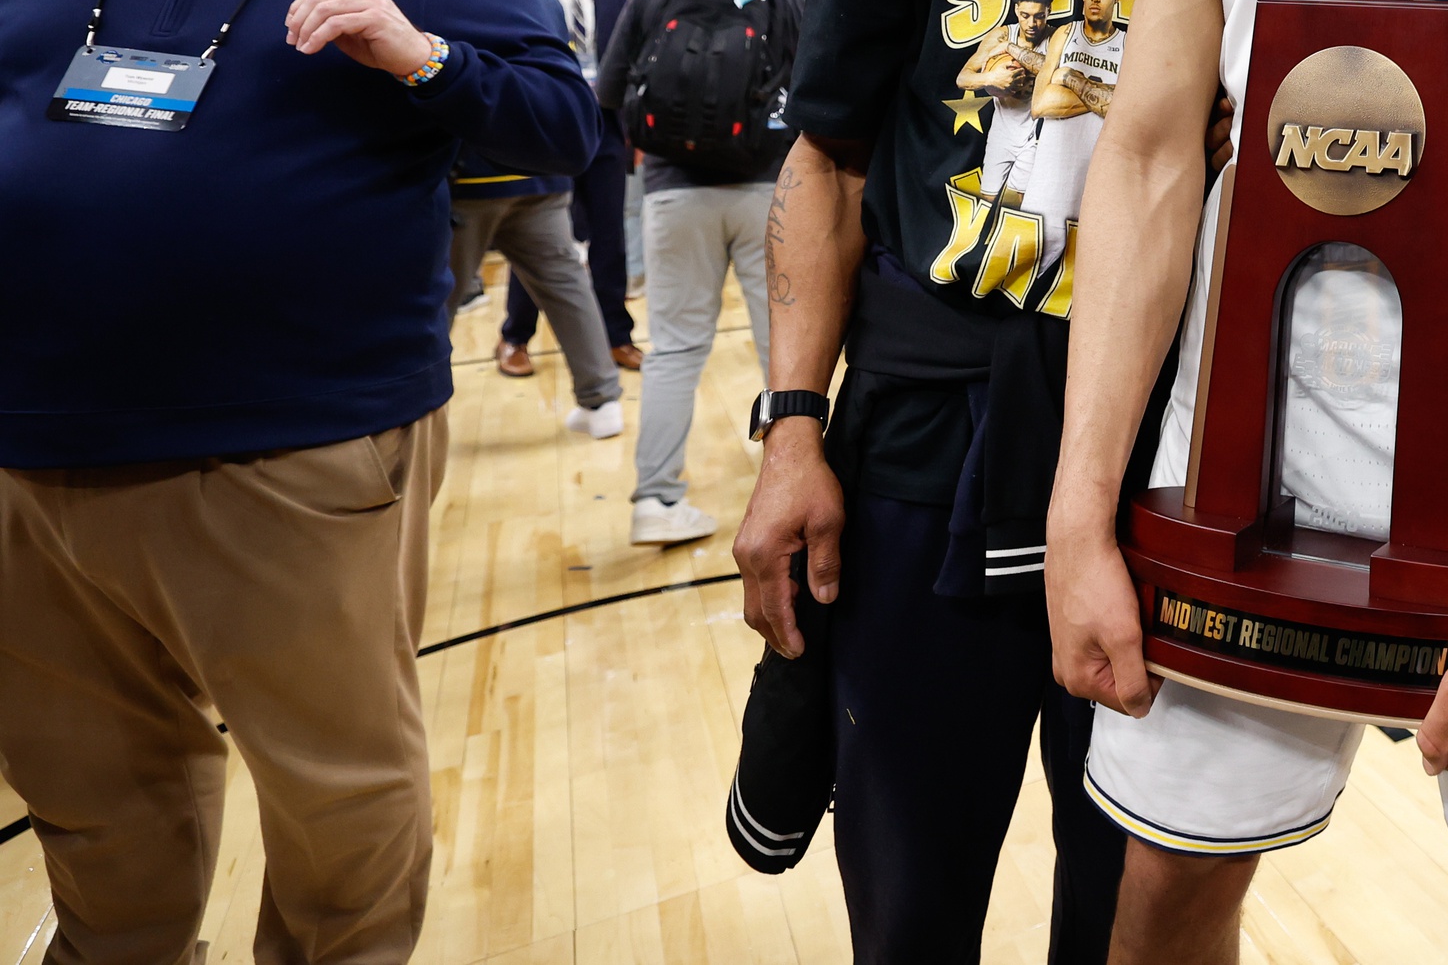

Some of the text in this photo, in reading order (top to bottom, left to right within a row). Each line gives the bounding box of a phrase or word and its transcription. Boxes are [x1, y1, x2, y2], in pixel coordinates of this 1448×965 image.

[1063, 51, 1119, 75] MICHIGAN
[64, 100, 144, 117] TEAM-REGIONAL
[144, 109, 176, 120] FINAL
[109, 94, 153, 106] CHICAGO
[1274, 124, 1414, 178] NCAA
[1159, 596, 1448, 676] MIDWEST REGIONAL CHAMPION
